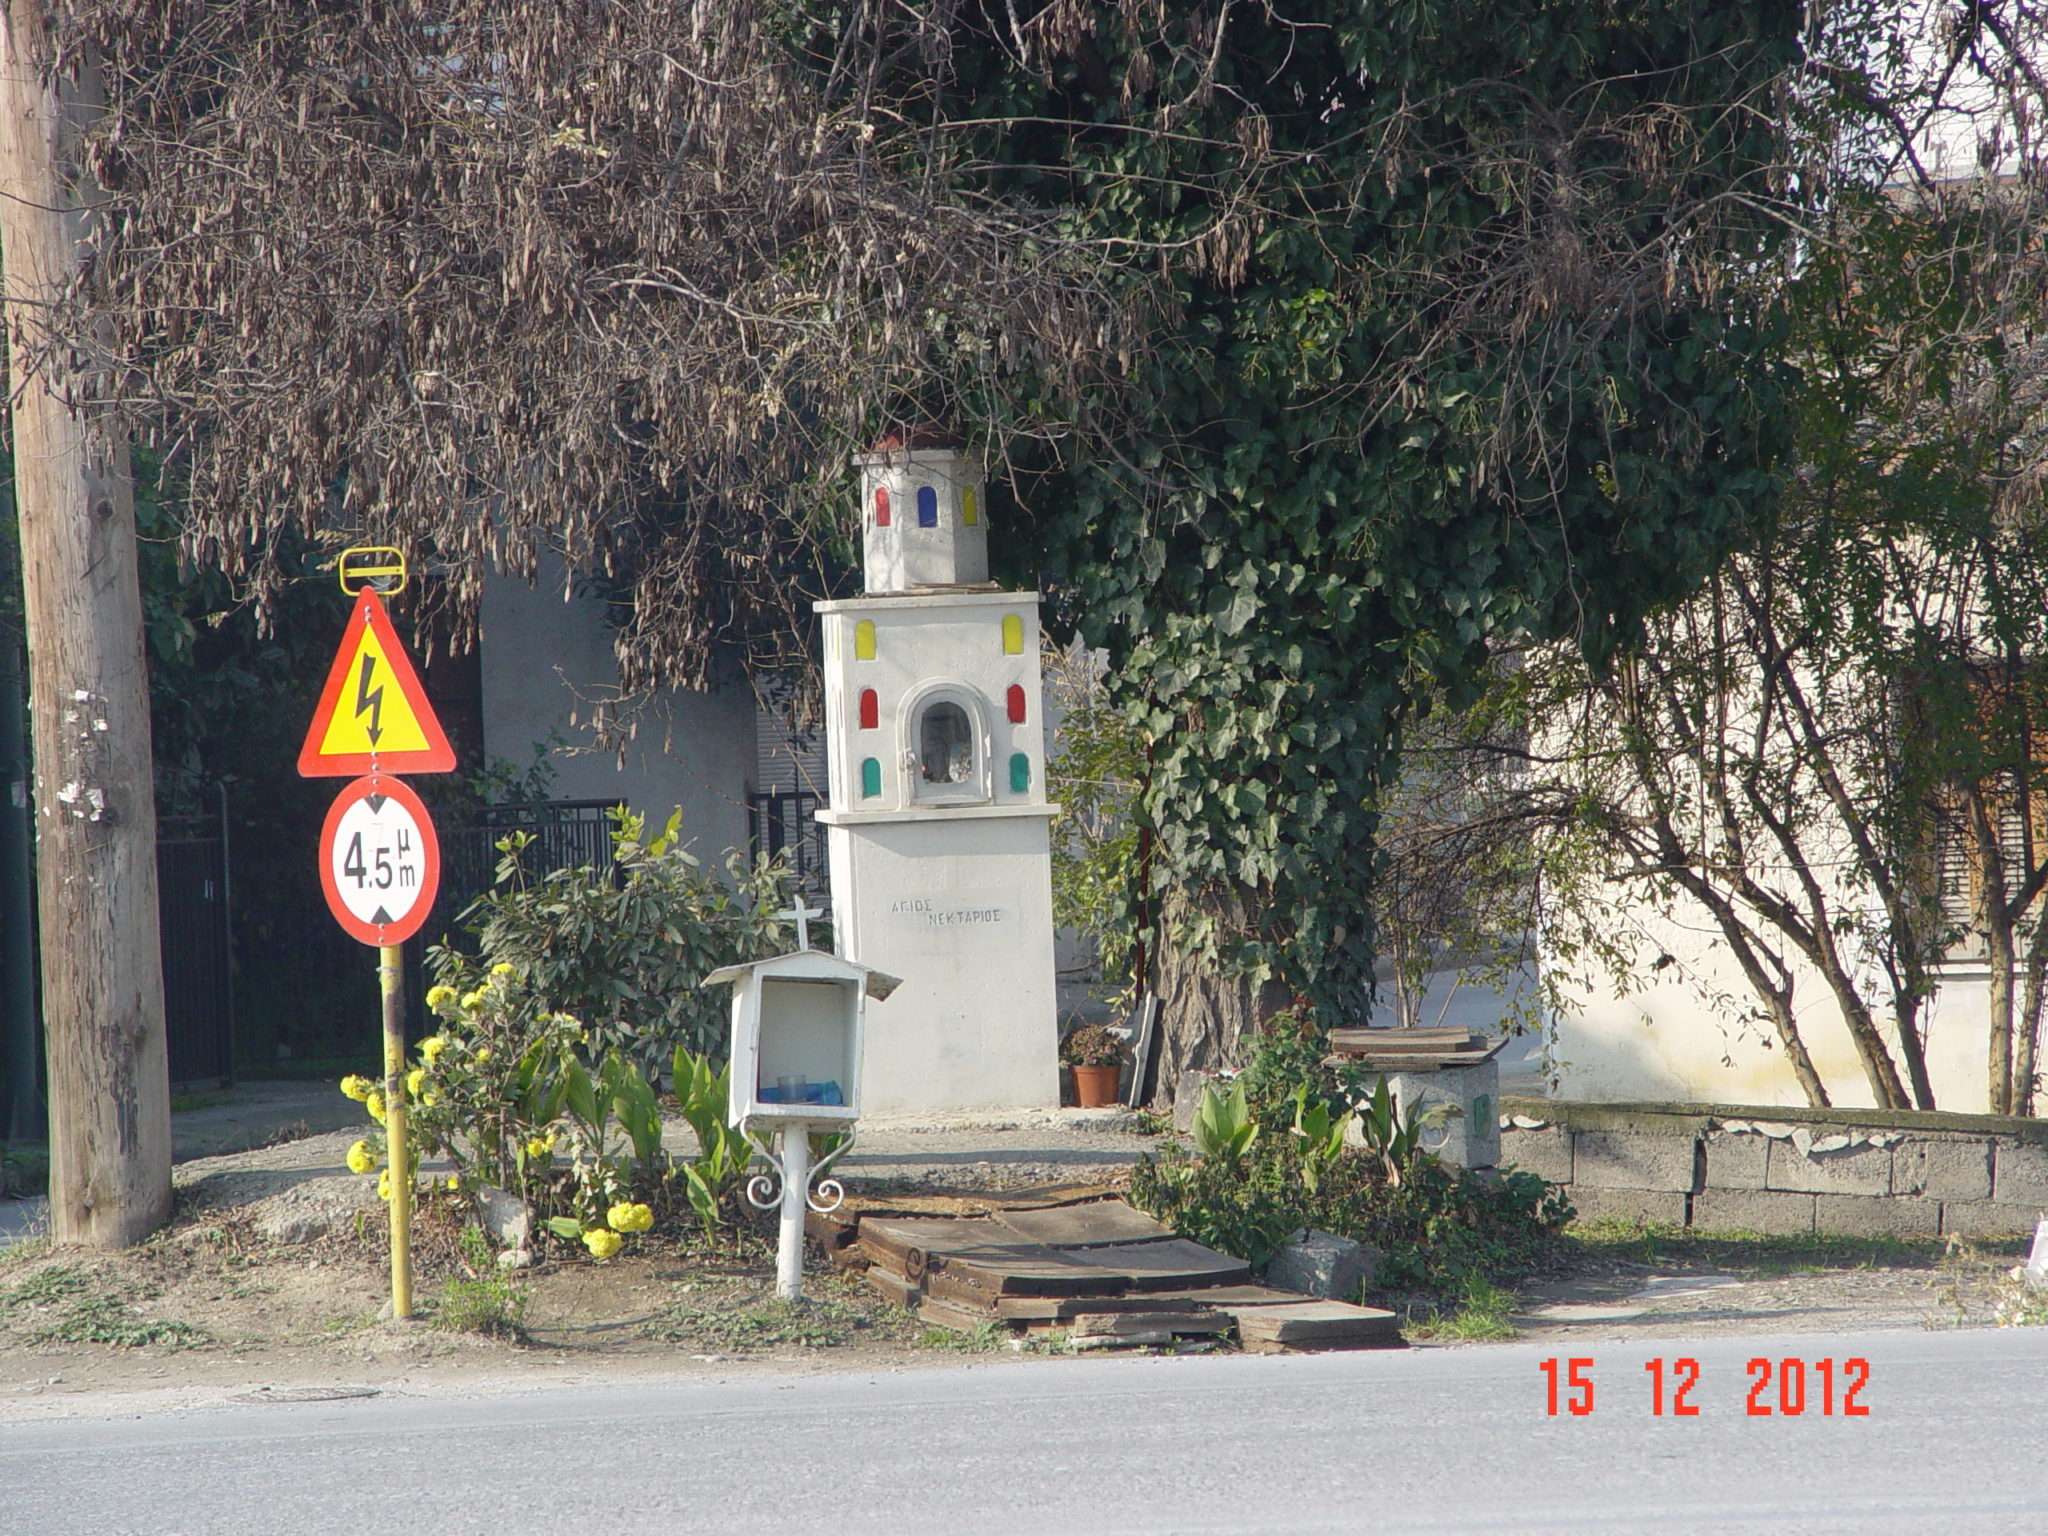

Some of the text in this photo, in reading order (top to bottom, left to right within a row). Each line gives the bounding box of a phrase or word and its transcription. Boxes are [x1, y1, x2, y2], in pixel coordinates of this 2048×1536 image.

[343, 831, 415, 890] 4.5 m
[891, 898, 933, 913] ΑΓΙΟΣ
[928, 908, 1001, 926] ΝΕΚΤΑΡΙΟΣ
